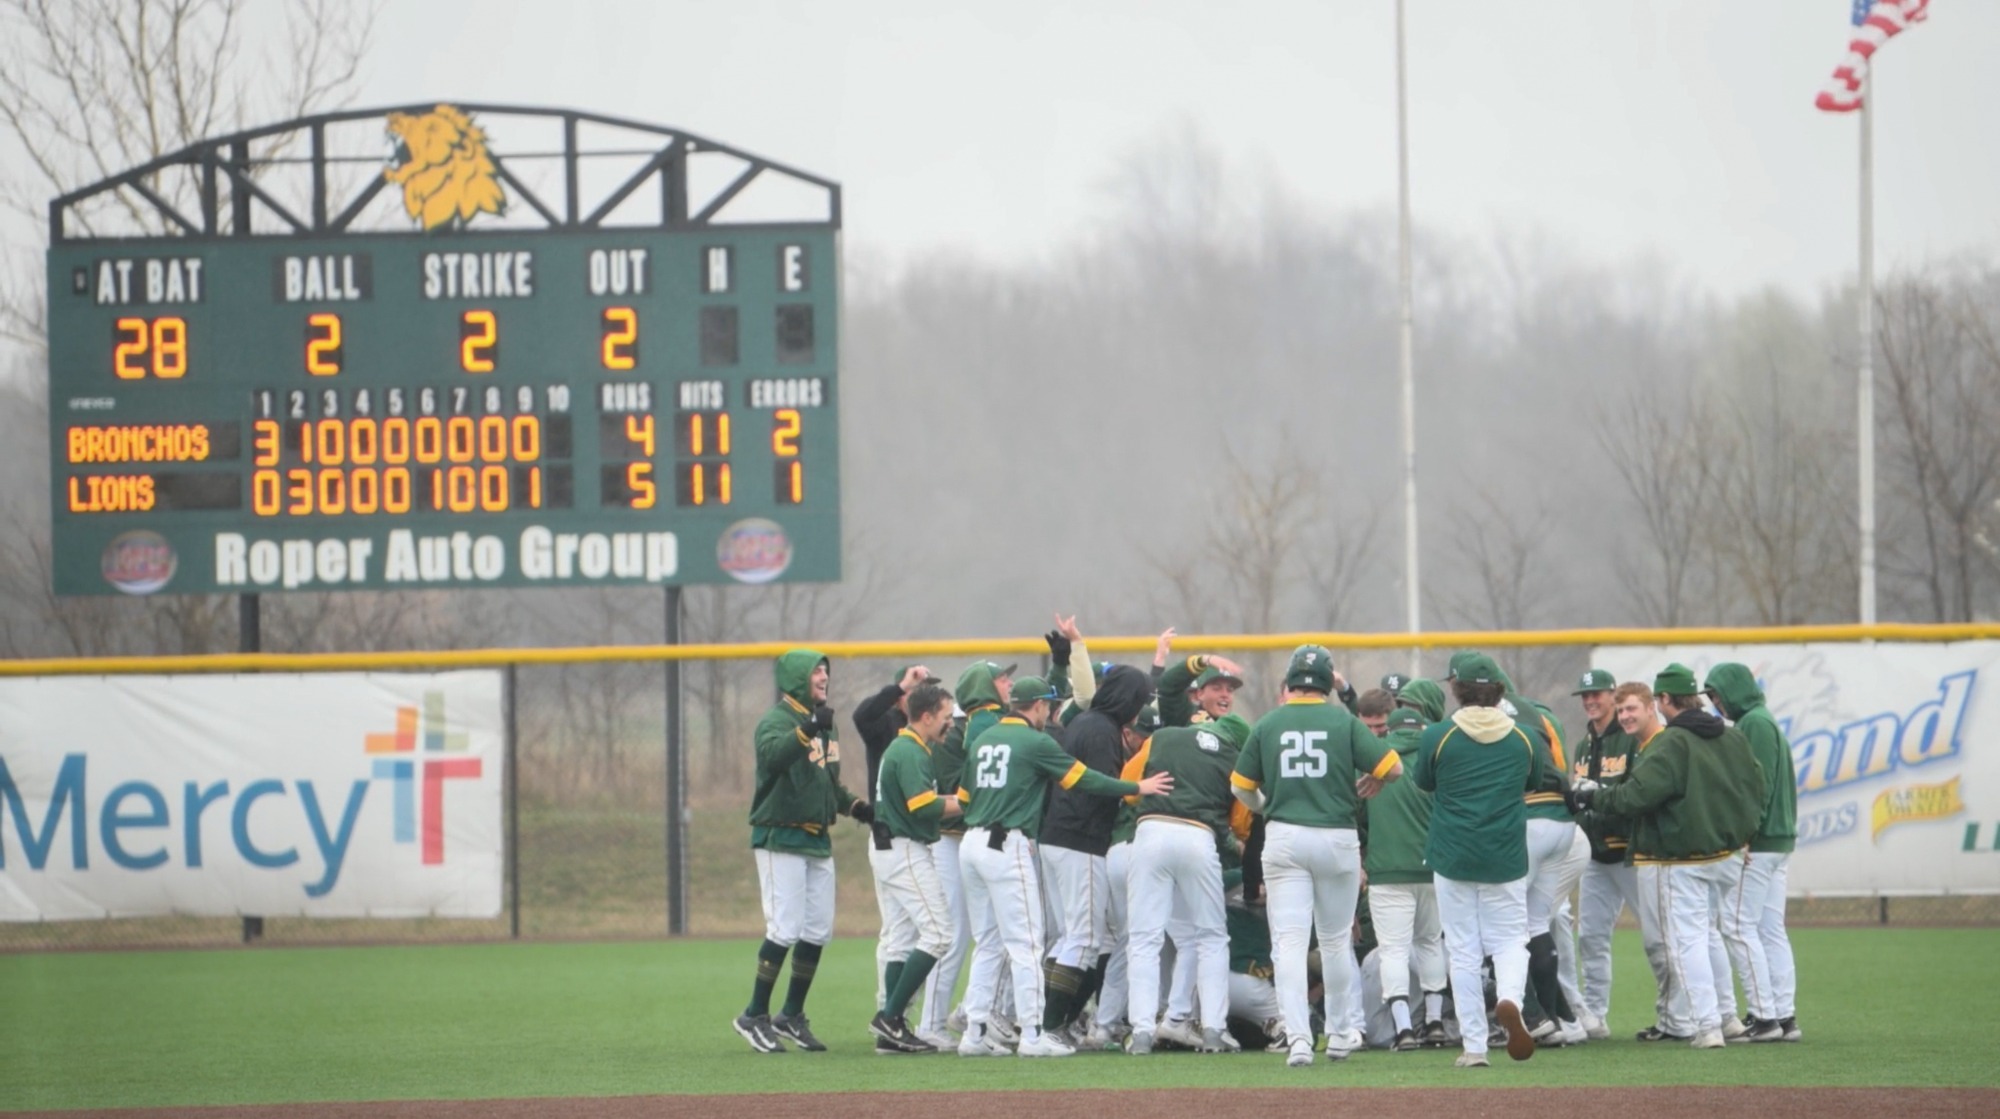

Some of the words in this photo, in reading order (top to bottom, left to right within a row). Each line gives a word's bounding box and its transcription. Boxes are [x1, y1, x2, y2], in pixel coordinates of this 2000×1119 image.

[98, 261, 132, 303] AT
[146, 259, 202, 302] BAT
[285, 256, 360, 300] BALL
[424, 252, 532, 298] STRIKE
[589, 249, 647, 295] OUT
[708, 247, 728, 293] H
[784, 245, 802, 291] E
[114, 317, 187, 380] 28
[305, 313, 342, 376] 2
[460, 310, 497, 372] 2
[601, 307, 638, 370] 2
[260, 391, 270, 418] 1
[290, 390, 304, 418] 2
[324, 389, 338, 417] 3
[355, 388, 370, 415] 4
[389, 388, 403, 416] 5
[421, 387, 435, 416] 6
[454, 387, 467, 414] 7
[485, 386, 501, 414] 8
[517, 385, 533, 413] 9
[547, 384, 570, 412] 10
[602, 382, 651, 412] RUNS
[679, 380, 724, 410] HITS
[750, 377, 822, 409] ERRORS
[67, 424, 210, 463] BRONCHOS
[625, 415, 655, 457] 4
[690, 413, 730, 455] 11
[772, 409, 801, 456] 2
[68, 474, 156, 512] LIONS
[626, 462, 656, 510] 5
[691, 463, 731, 505] 11
[790, 461, 802, 503] 1
[215, 532, 373, 589] Roper
[384, 528, 505, 582] Auto
[520, 524, 679, 583] Group
[976, 744, 1011, 788] 23
[1280, 731, 1328, 778] 25
[0, 752, 370, 898] Mercy
